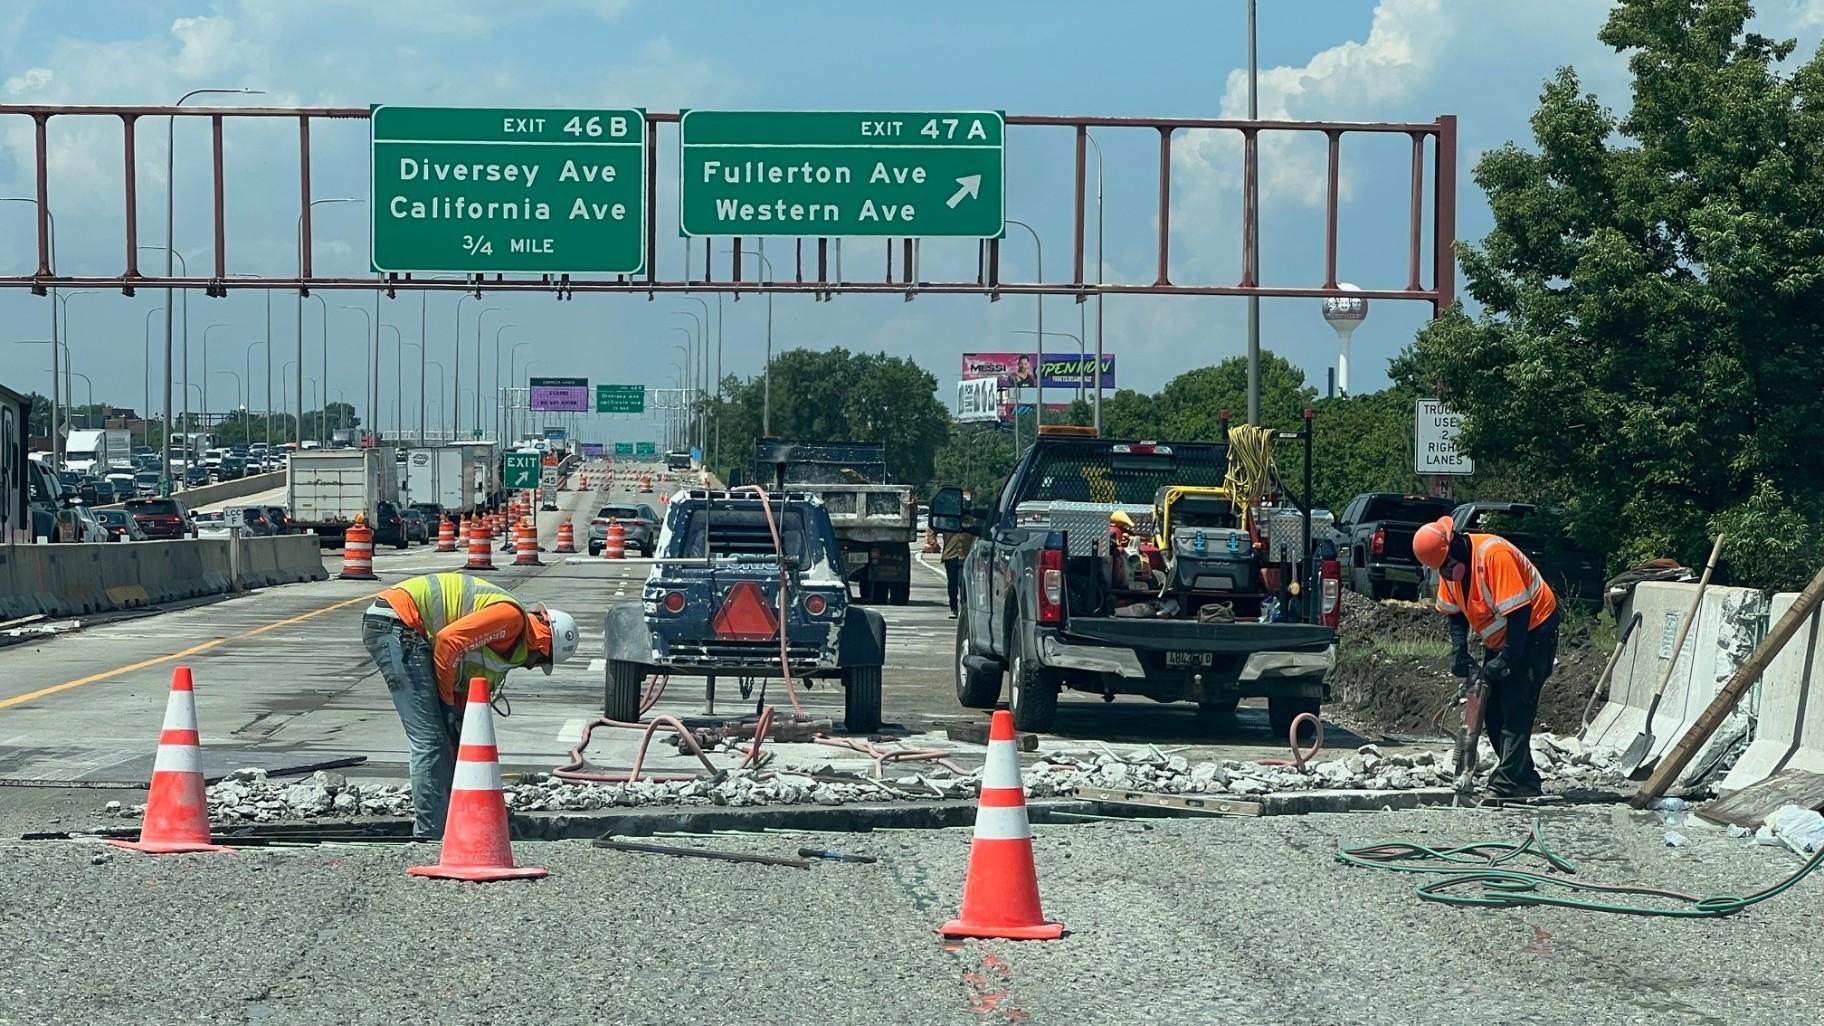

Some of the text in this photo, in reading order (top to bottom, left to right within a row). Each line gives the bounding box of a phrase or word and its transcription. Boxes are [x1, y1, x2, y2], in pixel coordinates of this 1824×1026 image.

[504, 116, 628, 137] EXIT 46 B
[861, 118, 987, 140] EXIT 47 A
[400, 158, 616, 187] Diversey Ave
[704, 161, 926, 184] Fullerton Ave
[390, 196, 626, 220] California Ave
[716, 199, 915, 221] Western Ave
[510, 238, 554, 253] MILE
[970, 364, 1007, 372] MESSI
[1423, 404, 1458, 415] TRUC
[1434, 417, 1457, 428] USE
[1441, 430, 1449, 440] 2
[1428, 442, 1456, 452] RIGH
[507, 457, 537, 468] EXIT
[1426, 455, 1463, 465] LANES
[225, 509, 241, 517] LCC
[231, 516, 237, 525] F
